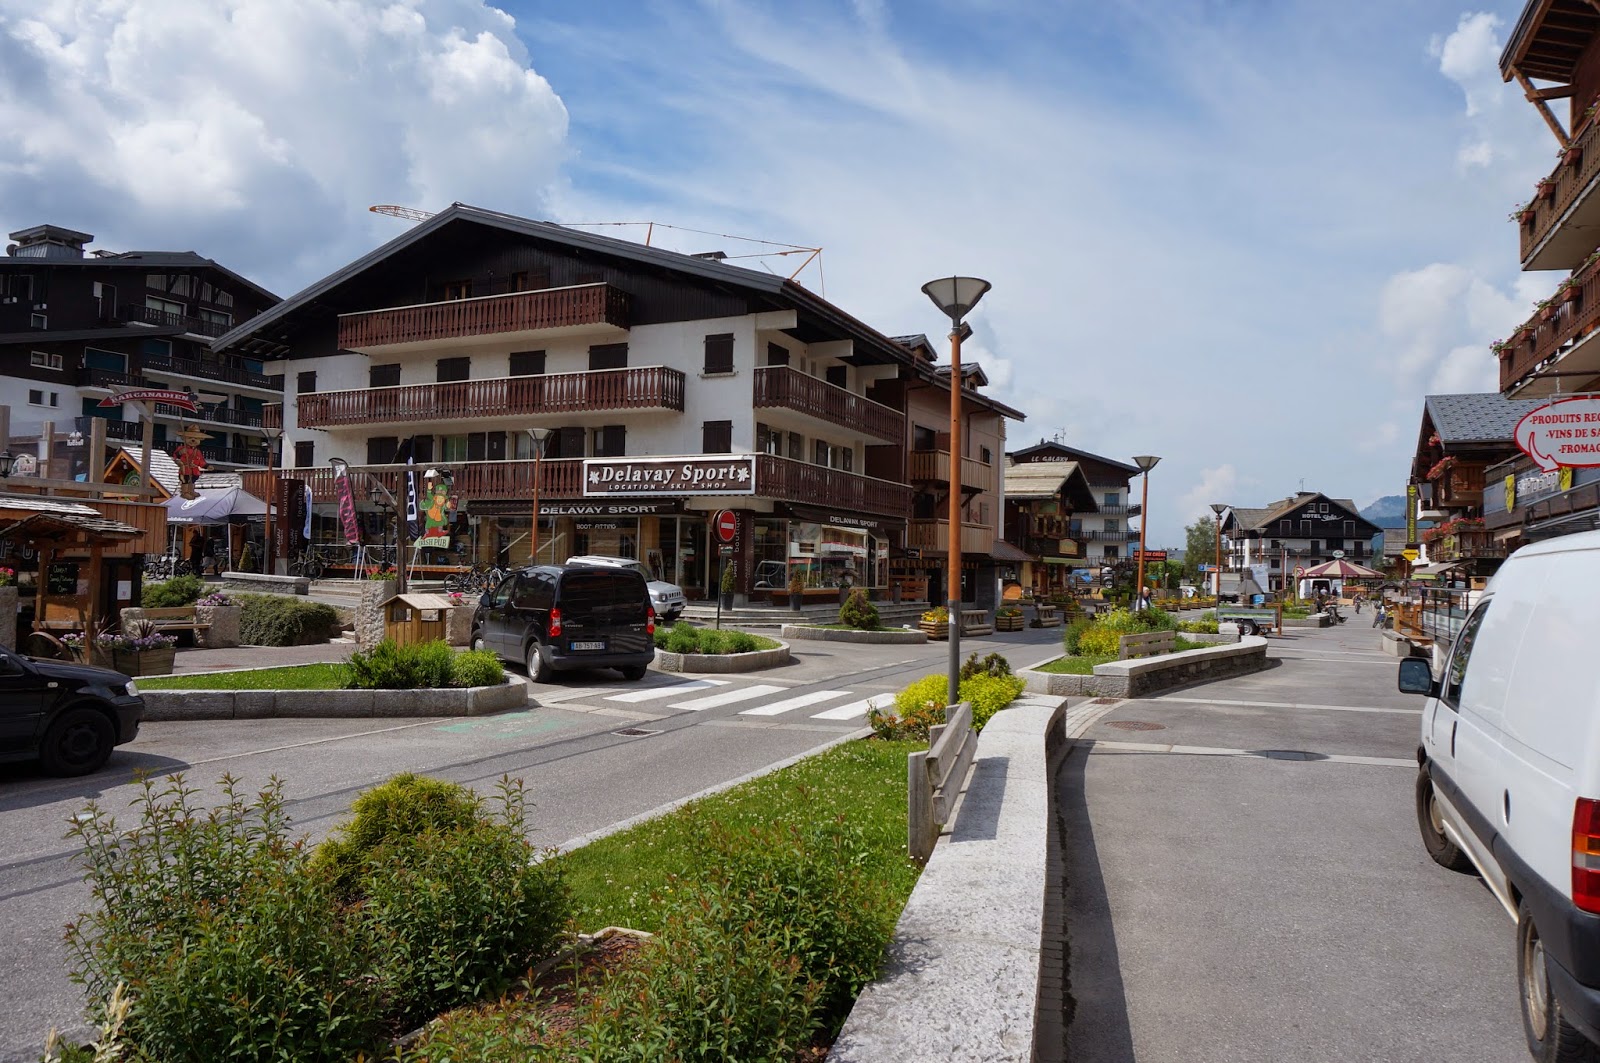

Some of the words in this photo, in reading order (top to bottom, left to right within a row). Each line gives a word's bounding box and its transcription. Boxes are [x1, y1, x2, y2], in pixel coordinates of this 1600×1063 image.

[134, 391, 189, 401] CANADIEN
[1575, 428, 1588, 438] DE
[601, 465, 675, 484] Delavay
[681, 464, 738, 484] Sport
[540, 506, 603, 514] DELAVAY
[608, 505, 658, 514] SPORT
[859, 519, 878, 528] SPORT
[418, 538, 433, 547] IRISH
[434, 538, 447, 547] PUB
